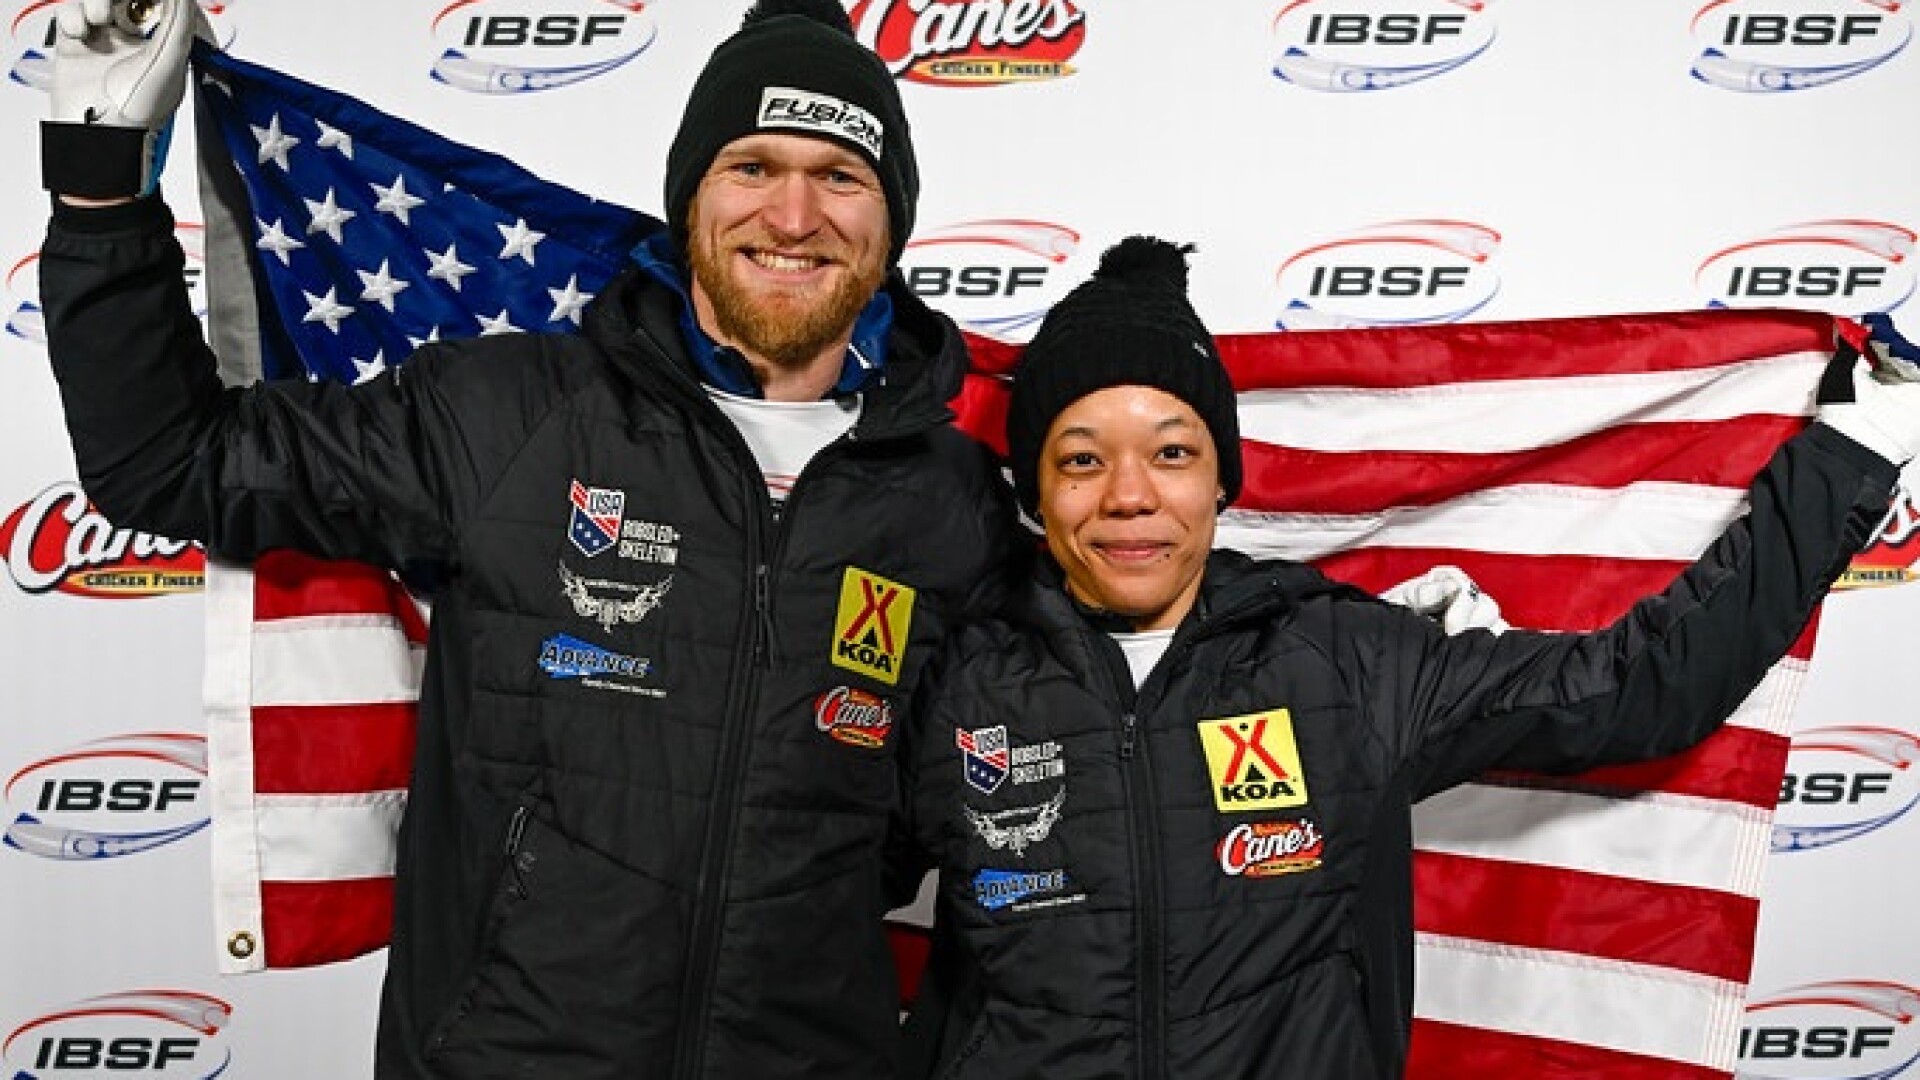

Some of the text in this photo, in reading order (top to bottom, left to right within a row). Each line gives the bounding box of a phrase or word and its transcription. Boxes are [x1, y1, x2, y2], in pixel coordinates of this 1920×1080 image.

[463, 16, 625, 46] IBSF
[846, 0, 1085, 75] Canes
[1306, 15, 1466, 46] IBSF
[1723, 15, 1882, 46] IBSF
[907, 266, 1048, 297] BSF
[1309, 266, 1469, 297] IBSF
[1728, 266, 1886, 297] IBSF
[838, 639, 893, 673] KOA
[36, 779, 201, 812] IBSF
[1220, 780, 1297, 802] KOA
[1221, 818, 1323, 876] Cane's
[34, 1036, 200, 1070] IBSF
